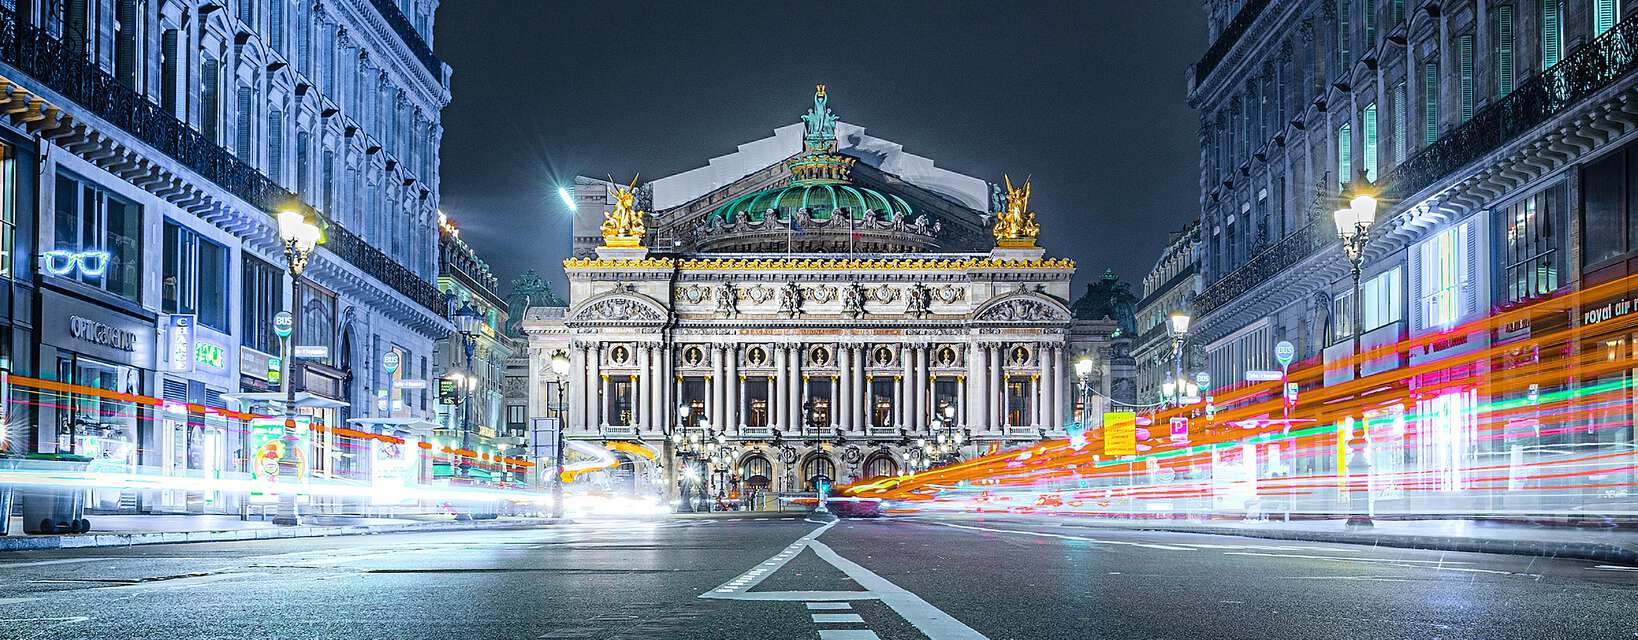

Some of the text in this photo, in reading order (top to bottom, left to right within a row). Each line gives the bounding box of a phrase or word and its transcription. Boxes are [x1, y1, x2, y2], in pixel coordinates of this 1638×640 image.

[1584, 303, 1612, 325] royal
[1615, 299, 1631, 317] air
[276, 316, 292, 325] BUS
[1174, 421, 1183, 432] P
